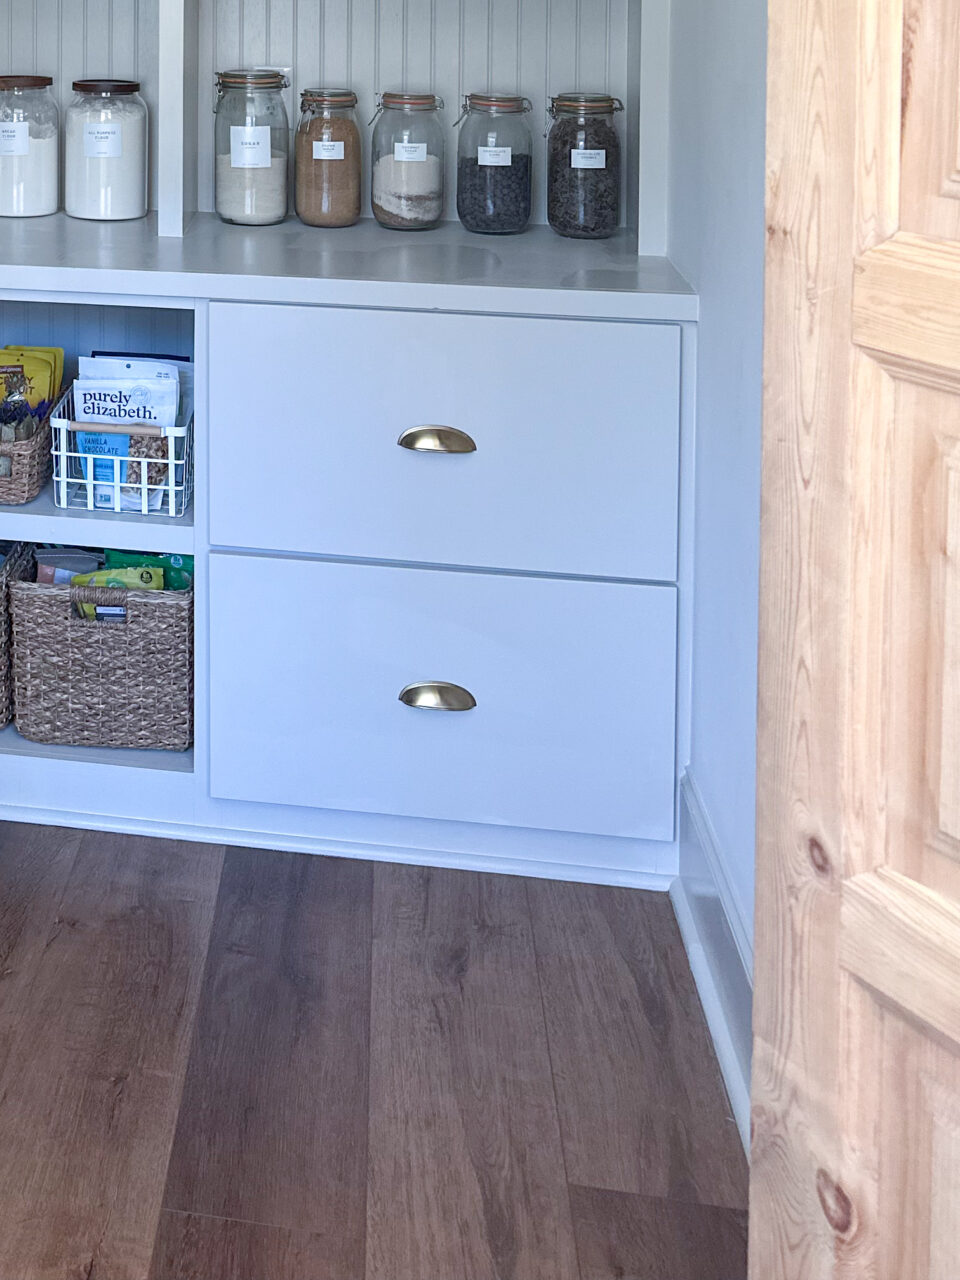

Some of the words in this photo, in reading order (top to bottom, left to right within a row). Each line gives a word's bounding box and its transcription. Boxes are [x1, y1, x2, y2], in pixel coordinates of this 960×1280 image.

[82, 390, 132, 407] purely
[83, 402, 158, 420] elizabeth.
[84, 437, 108, 445] VANILLA
[83, 445, 119, 455] CHOCOLATE
